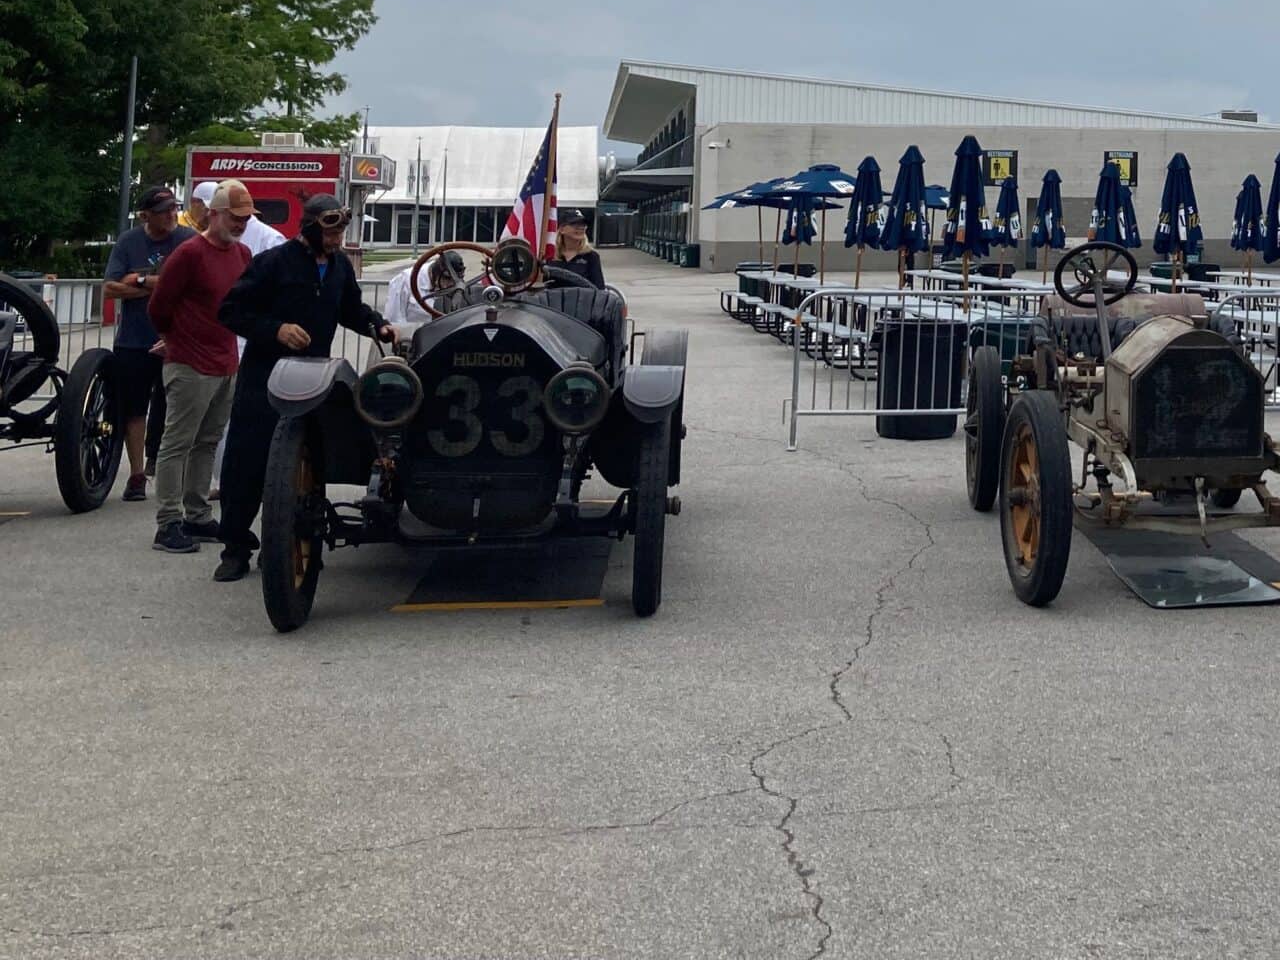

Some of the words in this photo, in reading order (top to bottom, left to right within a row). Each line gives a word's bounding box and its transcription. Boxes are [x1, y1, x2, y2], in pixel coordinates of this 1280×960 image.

[253, 161, 321, 171] CONCESSIONS
[453, 351, 525, 368] HUDSON
[427, 374, 545, 458] 33
